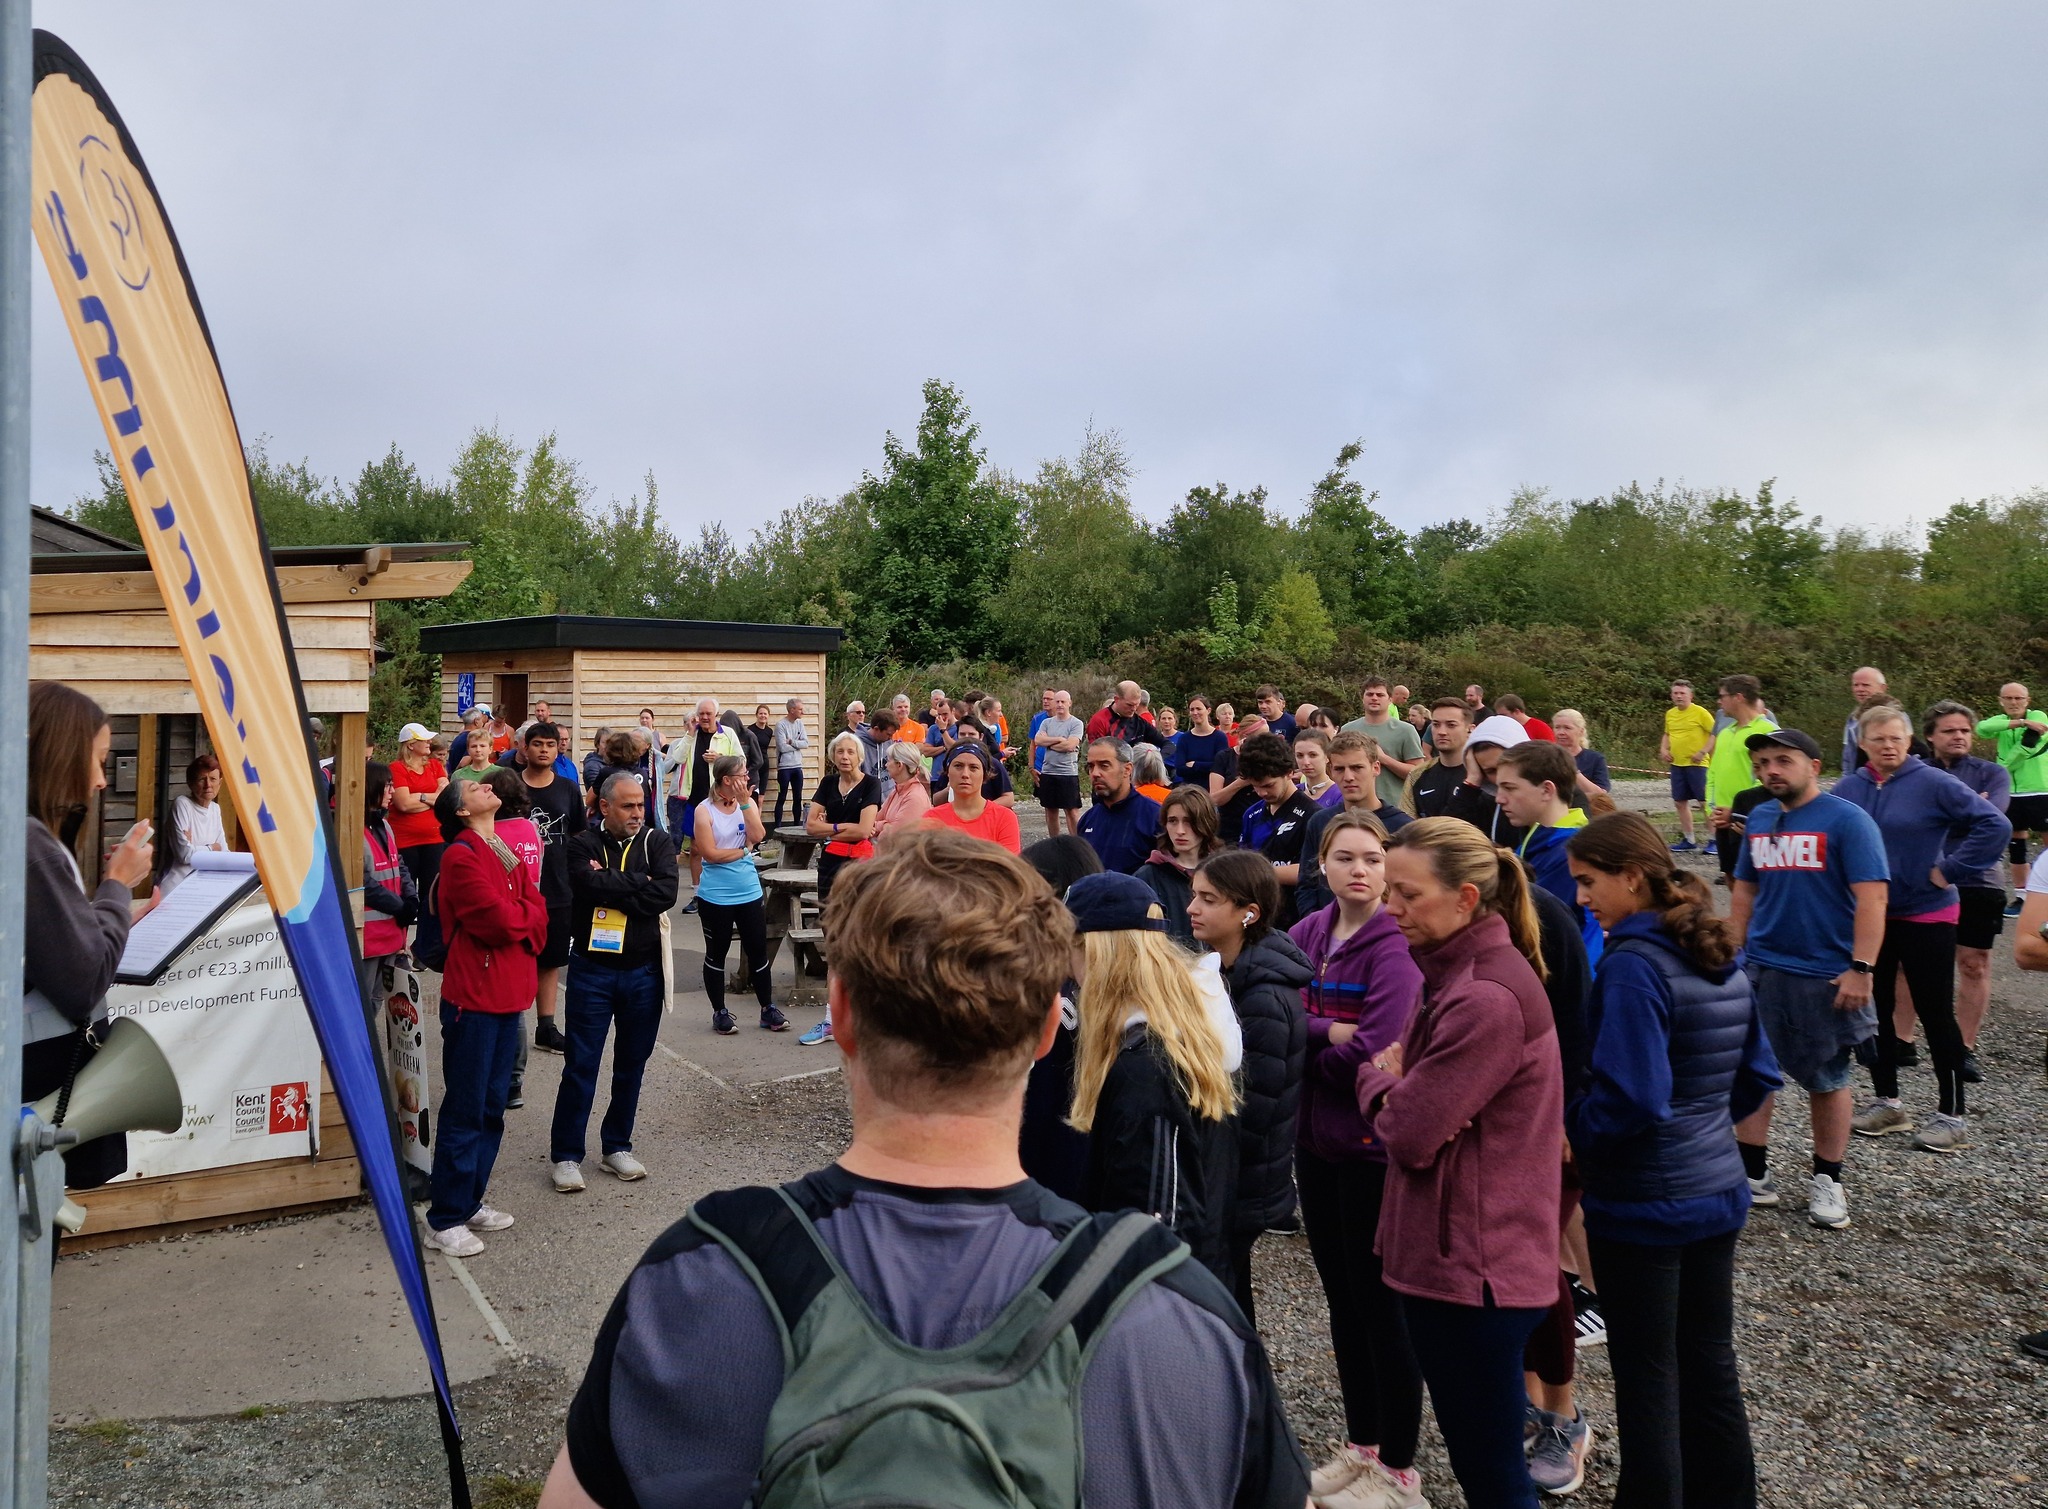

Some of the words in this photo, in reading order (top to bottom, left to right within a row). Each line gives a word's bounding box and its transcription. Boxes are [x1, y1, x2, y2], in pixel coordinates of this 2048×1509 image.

[190, 937, 223, 954] ect,
[228, 930, 280, 949] suppor
[156, 969, 183, 987] get
[187, 964, 205, 980] of
[208, 960, 251, 978] €23.3
[107, 1000, 142, 1018] onal
[149, 990, 255, 1013] Development
[260, 985, 302, 1001] Fund.
[236, 1093, 266, 1108] Kent
[235, 1106, 266, 1117] County
[185, 1114, 215, 1127] WAY
[235, 1114, 265, 1126] Council
